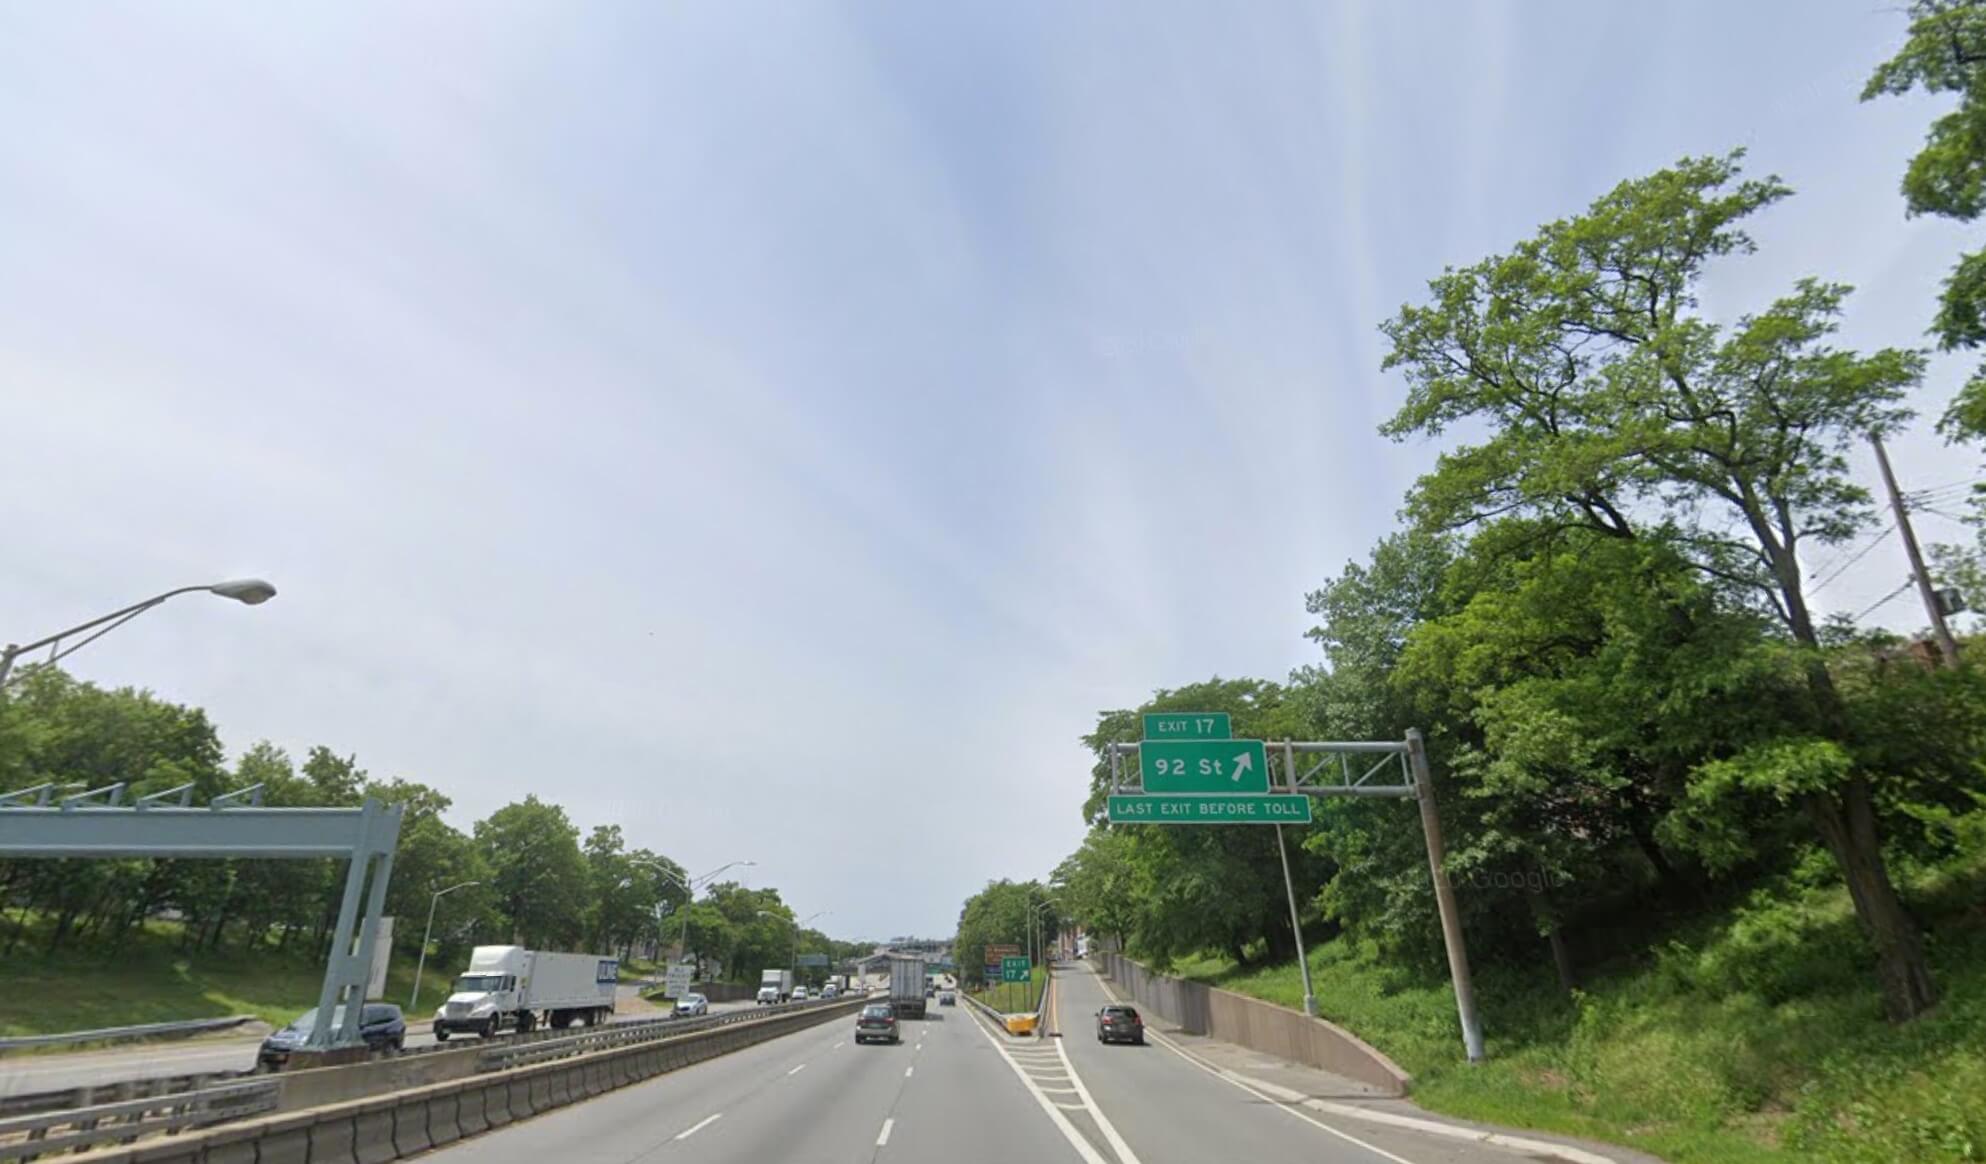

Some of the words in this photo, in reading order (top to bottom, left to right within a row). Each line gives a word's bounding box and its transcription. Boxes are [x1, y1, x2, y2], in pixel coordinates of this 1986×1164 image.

[1158, 720, 1187, 732] EXIT
[1196, 718, 1215, 734] 17
[1155, 758, 1186, 775] 92
[1199, 758, 1223, 775] St
[1116, 803, 1152, 815] LAST
[1160, 803, 1192, 815] EXIT
[1199, 803, 1256, 815] BEFORE
[1263, 803, 1300, 815] TOLL
[1006, 959, 1026, 968] EXIT
[1006, 970, 1016, 979] 17
